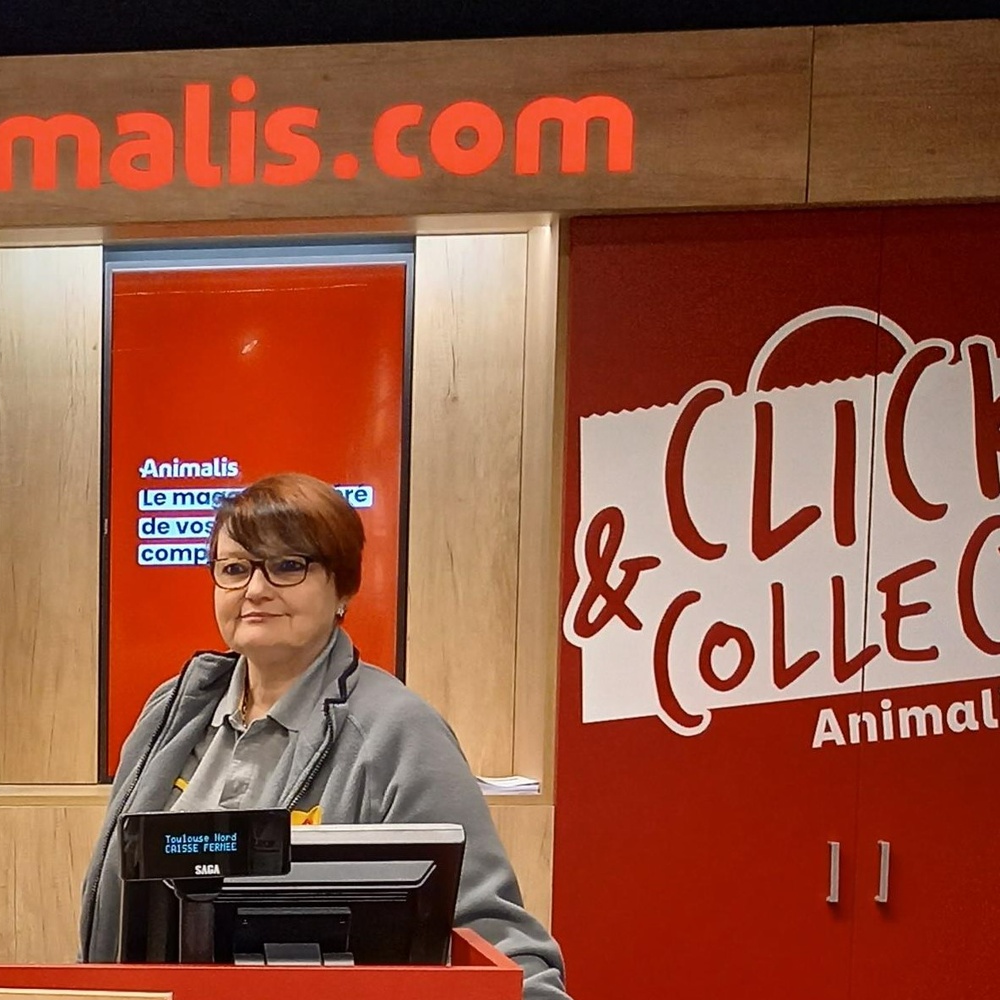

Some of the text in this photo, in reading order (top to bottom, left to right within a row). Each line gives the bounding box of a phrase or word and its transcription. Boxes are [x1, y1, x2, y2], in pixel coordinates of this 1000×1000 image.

[138, 457, 239, 478] Animalis
[143, 489, 167, 506] Le
[142, 518, 170, 535] de
[141, 546, 208, 565] comp
[573, 506, 662, 638] &
[165, 832, 237, 844] Toulouse Nord
[165, 842, 237, 853] CAISSE FERMEE
[195, 864, 220, 875] SAGA
